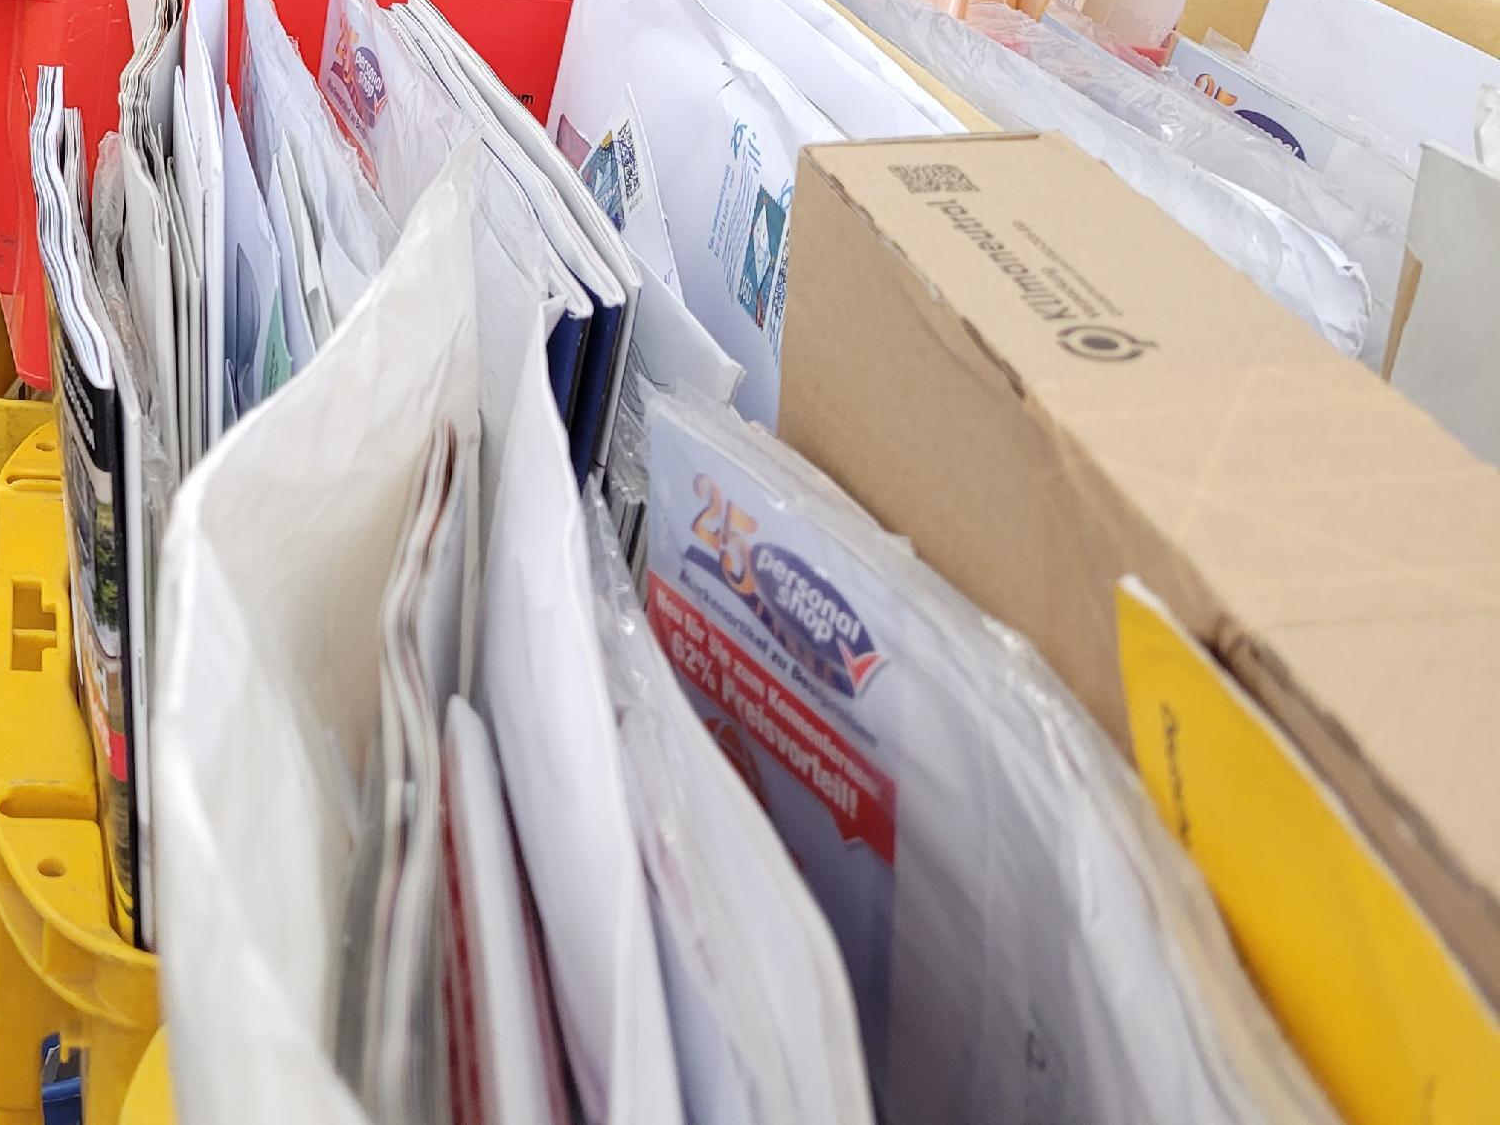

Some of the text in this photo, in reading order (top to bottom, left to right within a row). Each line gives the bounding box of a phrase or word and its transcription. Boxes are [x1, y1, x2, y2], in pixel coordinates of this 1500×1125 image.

[355, 50, 384, 95] personal
[358, 70, 376, 98] shop
[926, 199, 1078, 322] Klimaneutral
[691, 473, 759, 595] 25
[755, 548, 862, 645] personal
[775, 584, 835, 644] shop
[707, 631, 733, 667] Sie
[733, 659, 767, 698] zum
[769, 651, 788, 672] zu
[671, 630, 860, 821] 62% Preisvorteil!
